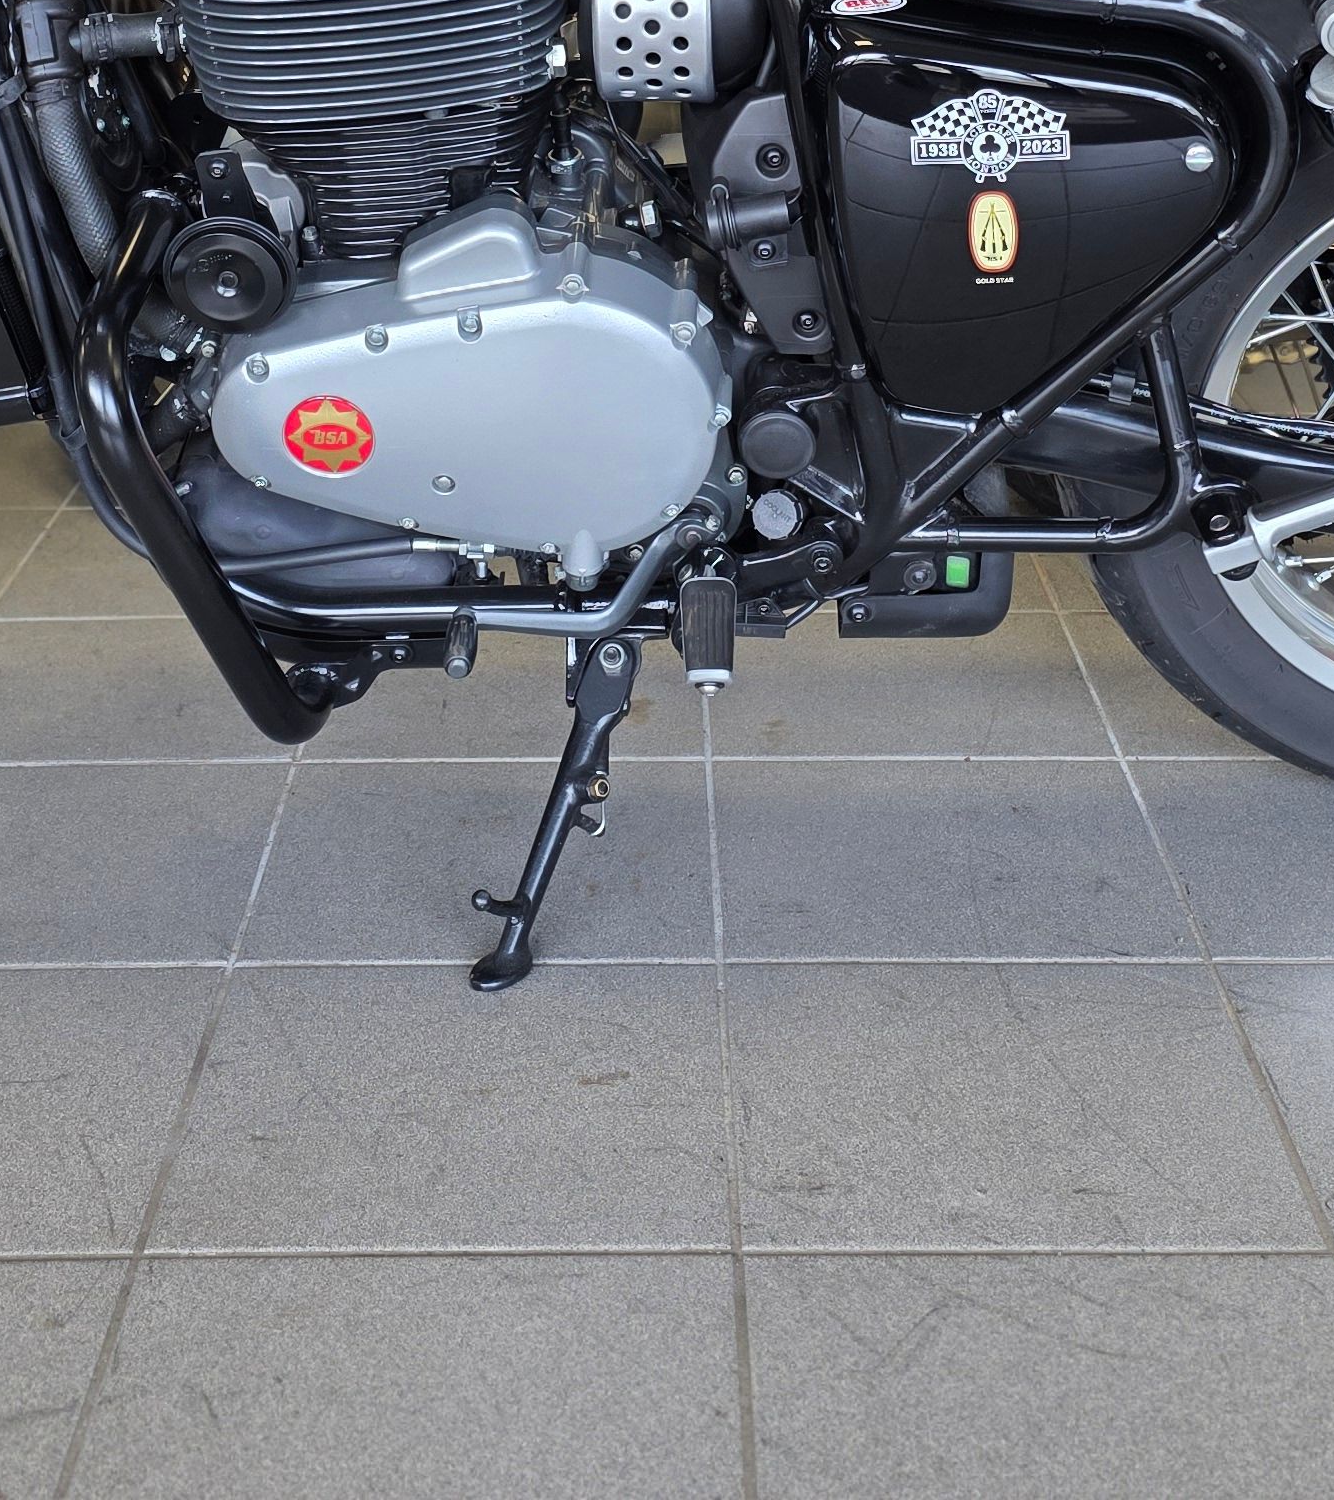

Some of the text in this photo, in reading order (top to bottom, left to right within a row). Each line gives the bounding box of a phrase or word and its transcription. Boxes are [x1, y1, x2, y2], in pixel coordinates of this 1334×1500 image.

[977, 95, 998, 109] 85
[965, 123, 1017, 146] ACE CAFE
[919, 142, 959, 158] 1938
[1021, 139, 1062, 154] 2023
[966, 152, 1016, 174] LONDON
[995, 276, 1014, 284] STAR
[308, 429, 348, 445] BSA
